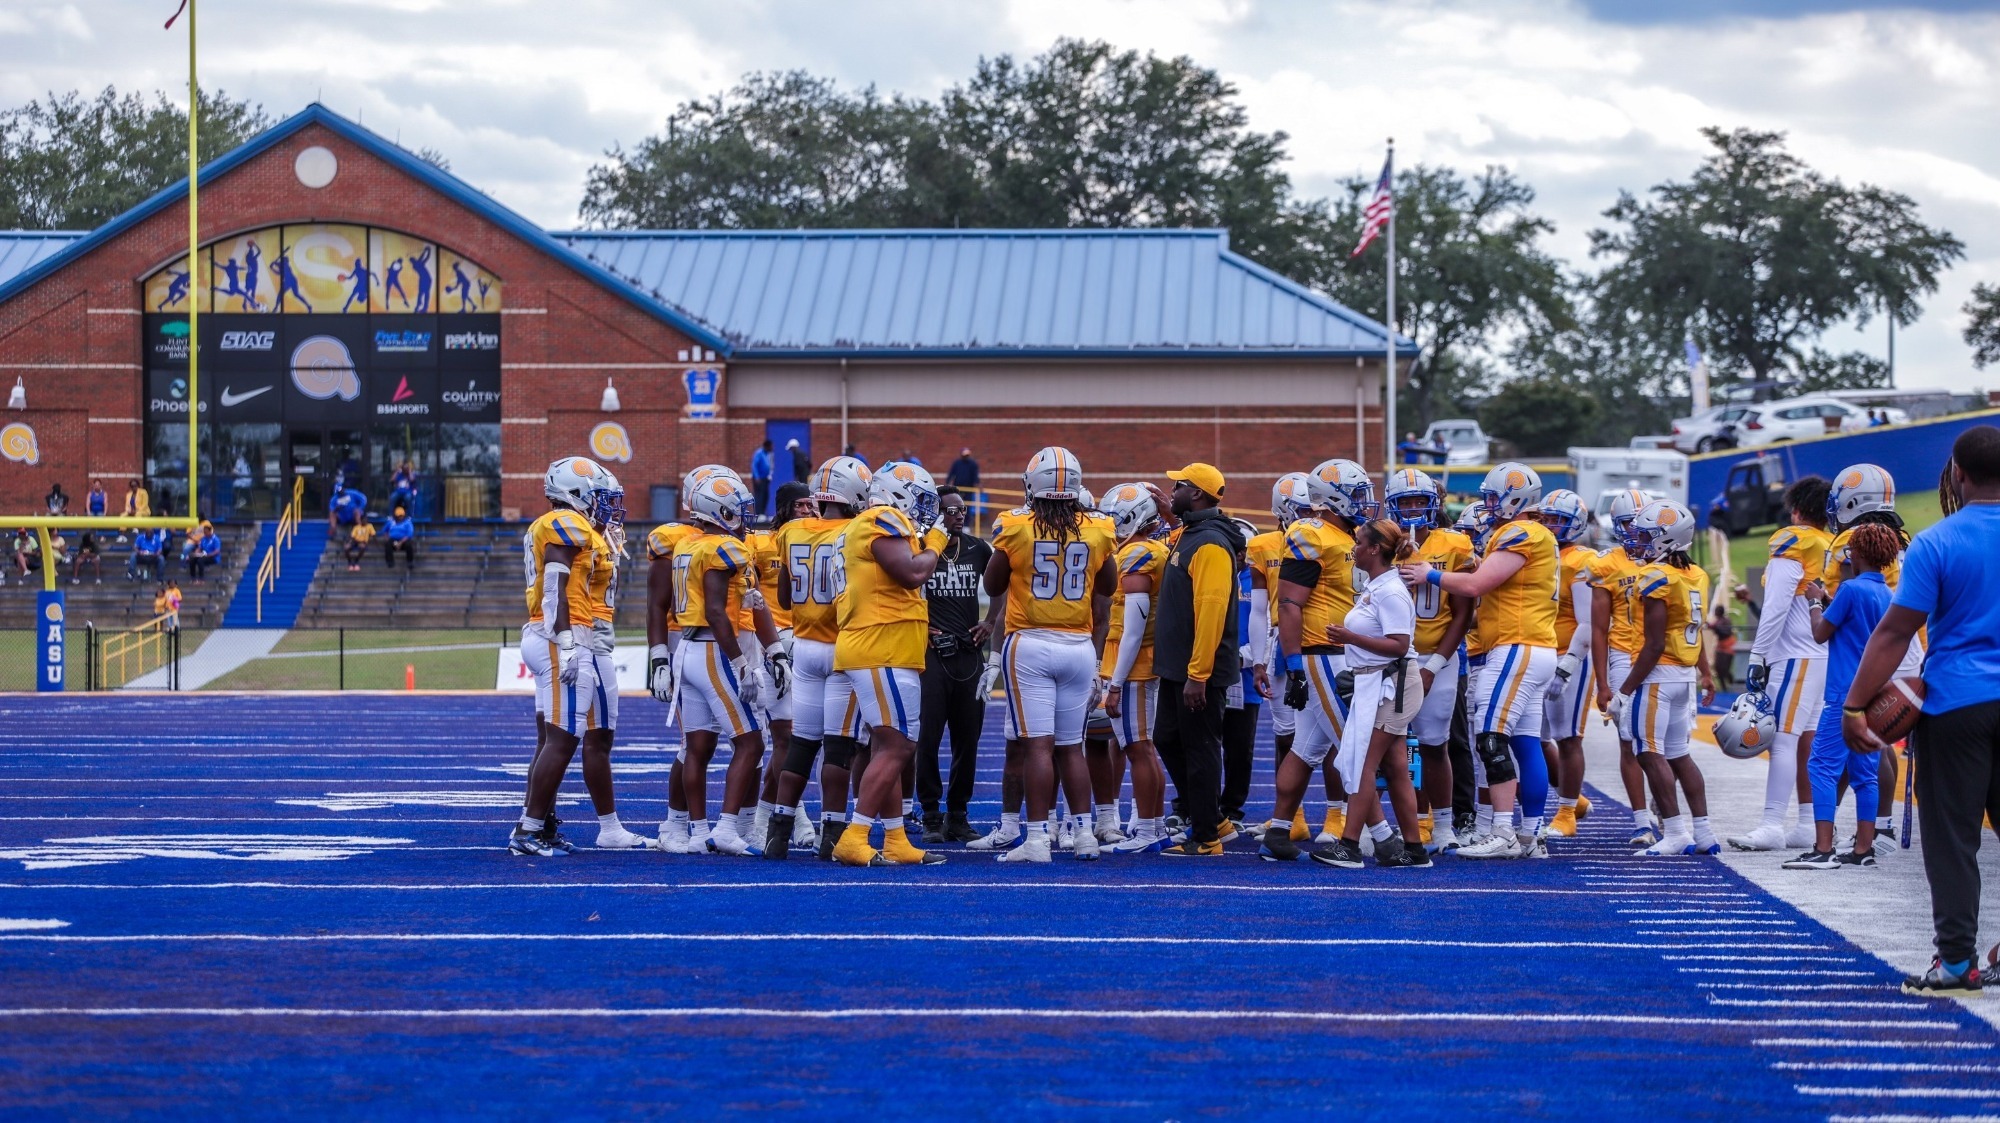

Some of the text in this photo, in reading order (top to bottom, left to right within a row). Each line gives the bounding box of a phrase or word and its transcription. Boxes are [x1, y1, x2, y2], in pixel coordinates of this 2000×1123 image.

[220, 331, 275, 351] SIAC
[445, 331, 499, 350] park inn
[151, 399, 207, 412] Phoee
[789, 543, 834, 604] 50
[1031, 540, 1090, 600] 58
[1618, 575, 1637, 588] ALBA
[47, 624, 63, 684] ASU
